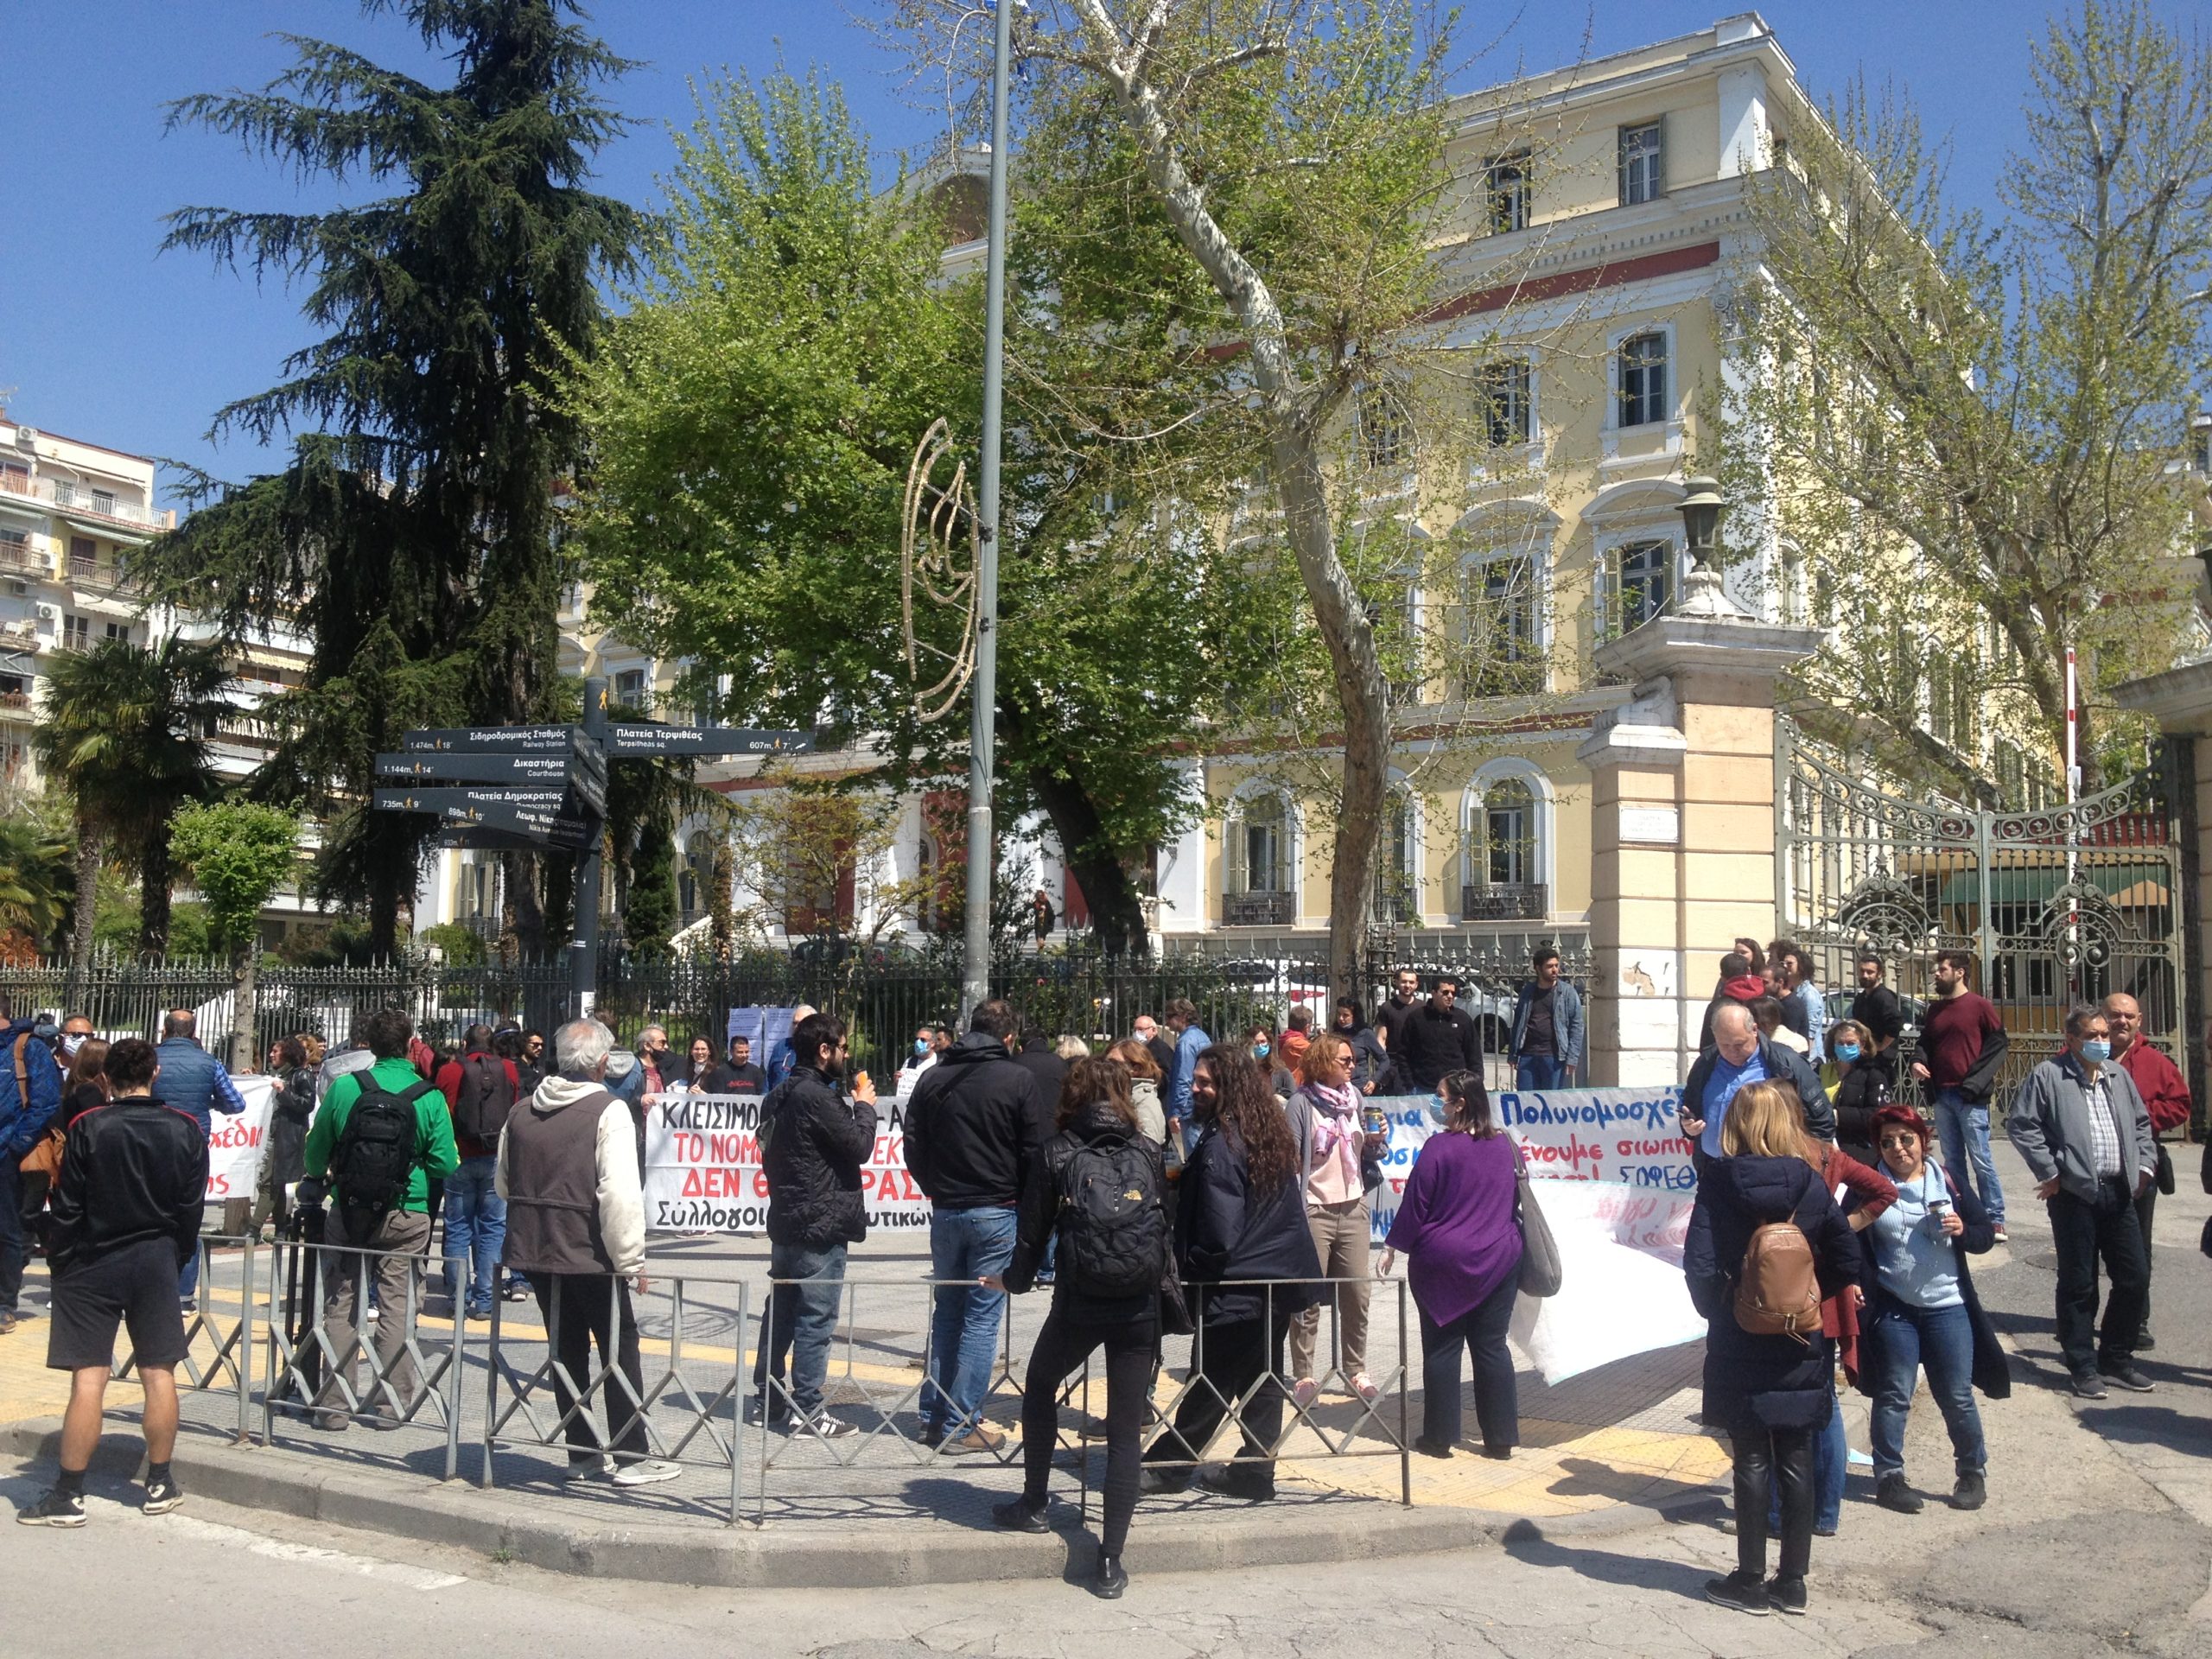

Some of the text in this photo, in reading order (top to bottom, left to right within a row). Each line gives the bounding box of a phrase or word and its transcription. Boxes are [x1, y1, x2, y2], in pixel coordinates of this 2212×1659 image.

[470, 728, 566, 742] Σιδηροδρομικός Σταθμός
[616, 728, 703, 741] Πλατεία Τερψιθέας
[523, 741, 544, 749] Railway
[513, 759, 564, 769] Δικαστήρια
[467, 791, 563, 802] Πλατεία Δημοκρατίας
[662, 1101, 759, 1131] ΚΛΕΙΣΙΜΟ
[673, 1133, 704, 1163] ΤΟ
[682, 1167, 741, 1198] ΔΕΝ
[656, 1199, 766, 1230] Σύλλογοι
